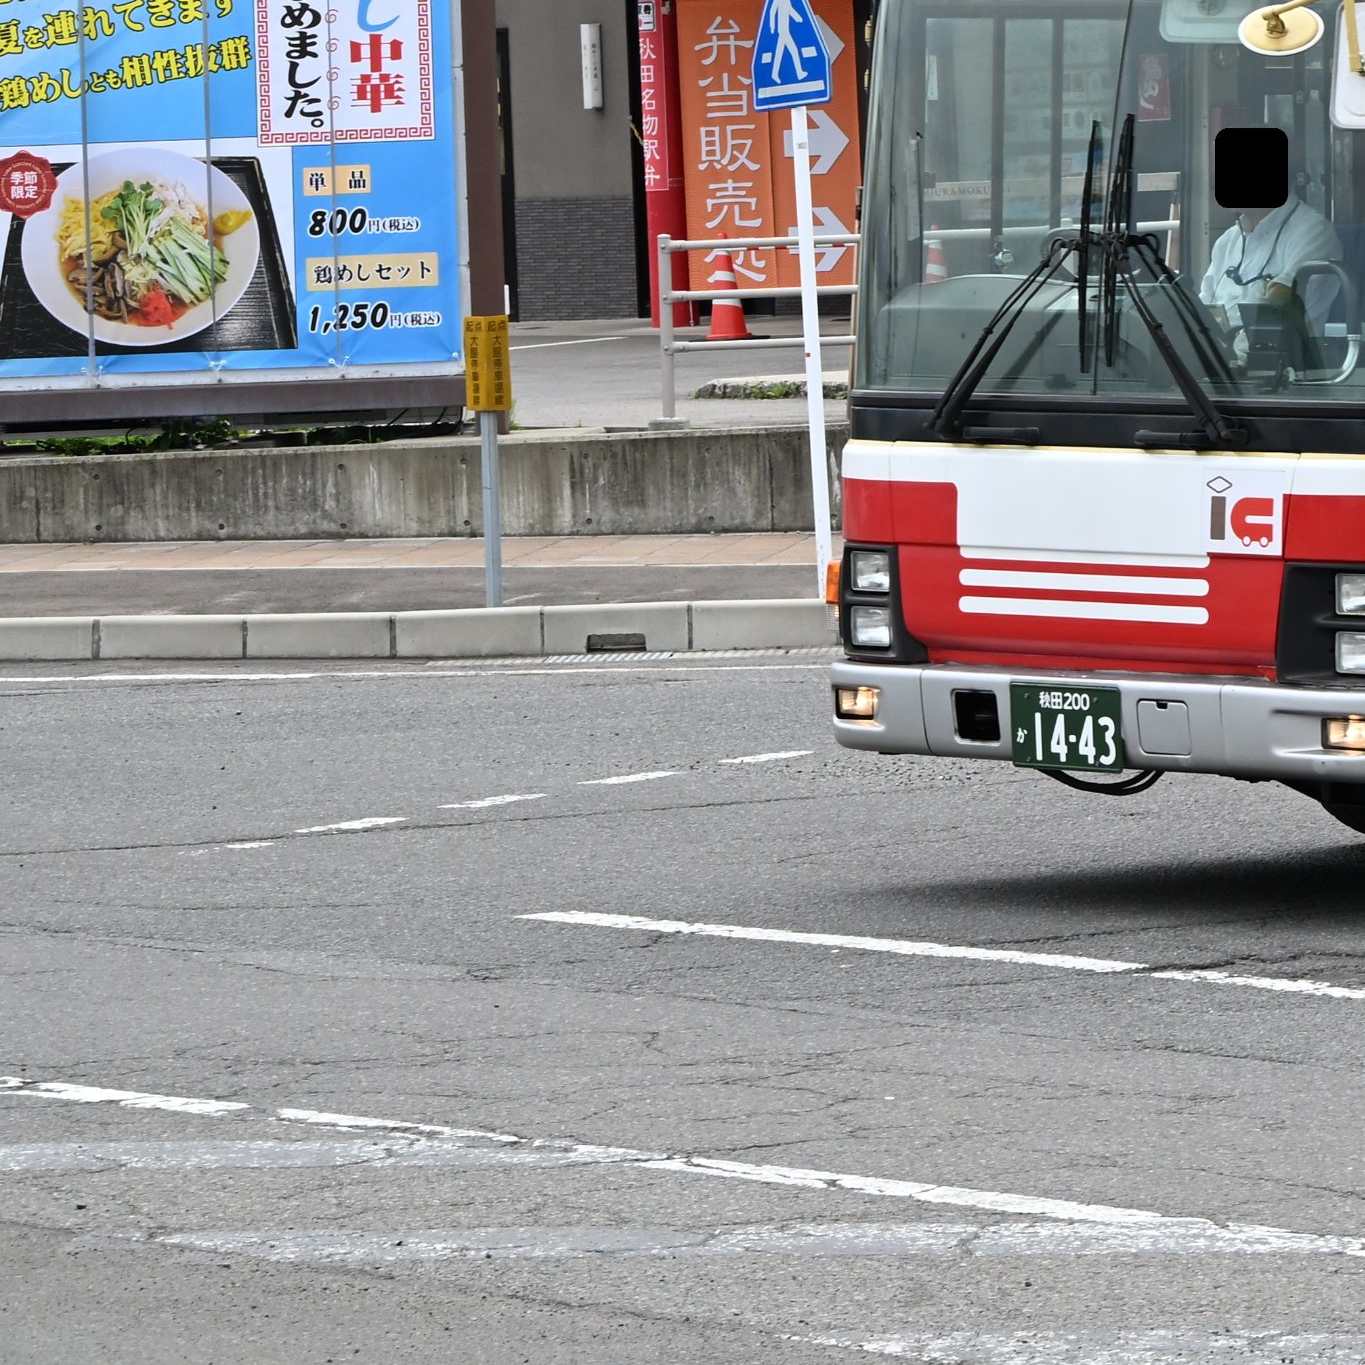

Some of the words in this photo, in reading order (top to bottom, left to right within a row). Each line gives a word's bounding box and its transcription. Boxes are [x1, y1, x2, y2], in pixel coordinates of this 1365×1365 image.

[639, 37, 661, 187] 秋田名物駅弁
[10, 171, 38, 185] 季節
[11, 186, 38, 199] 限定
[314, 261, 432, 284] 鶏めしセット
[1016, 727, 1028, 743] か
